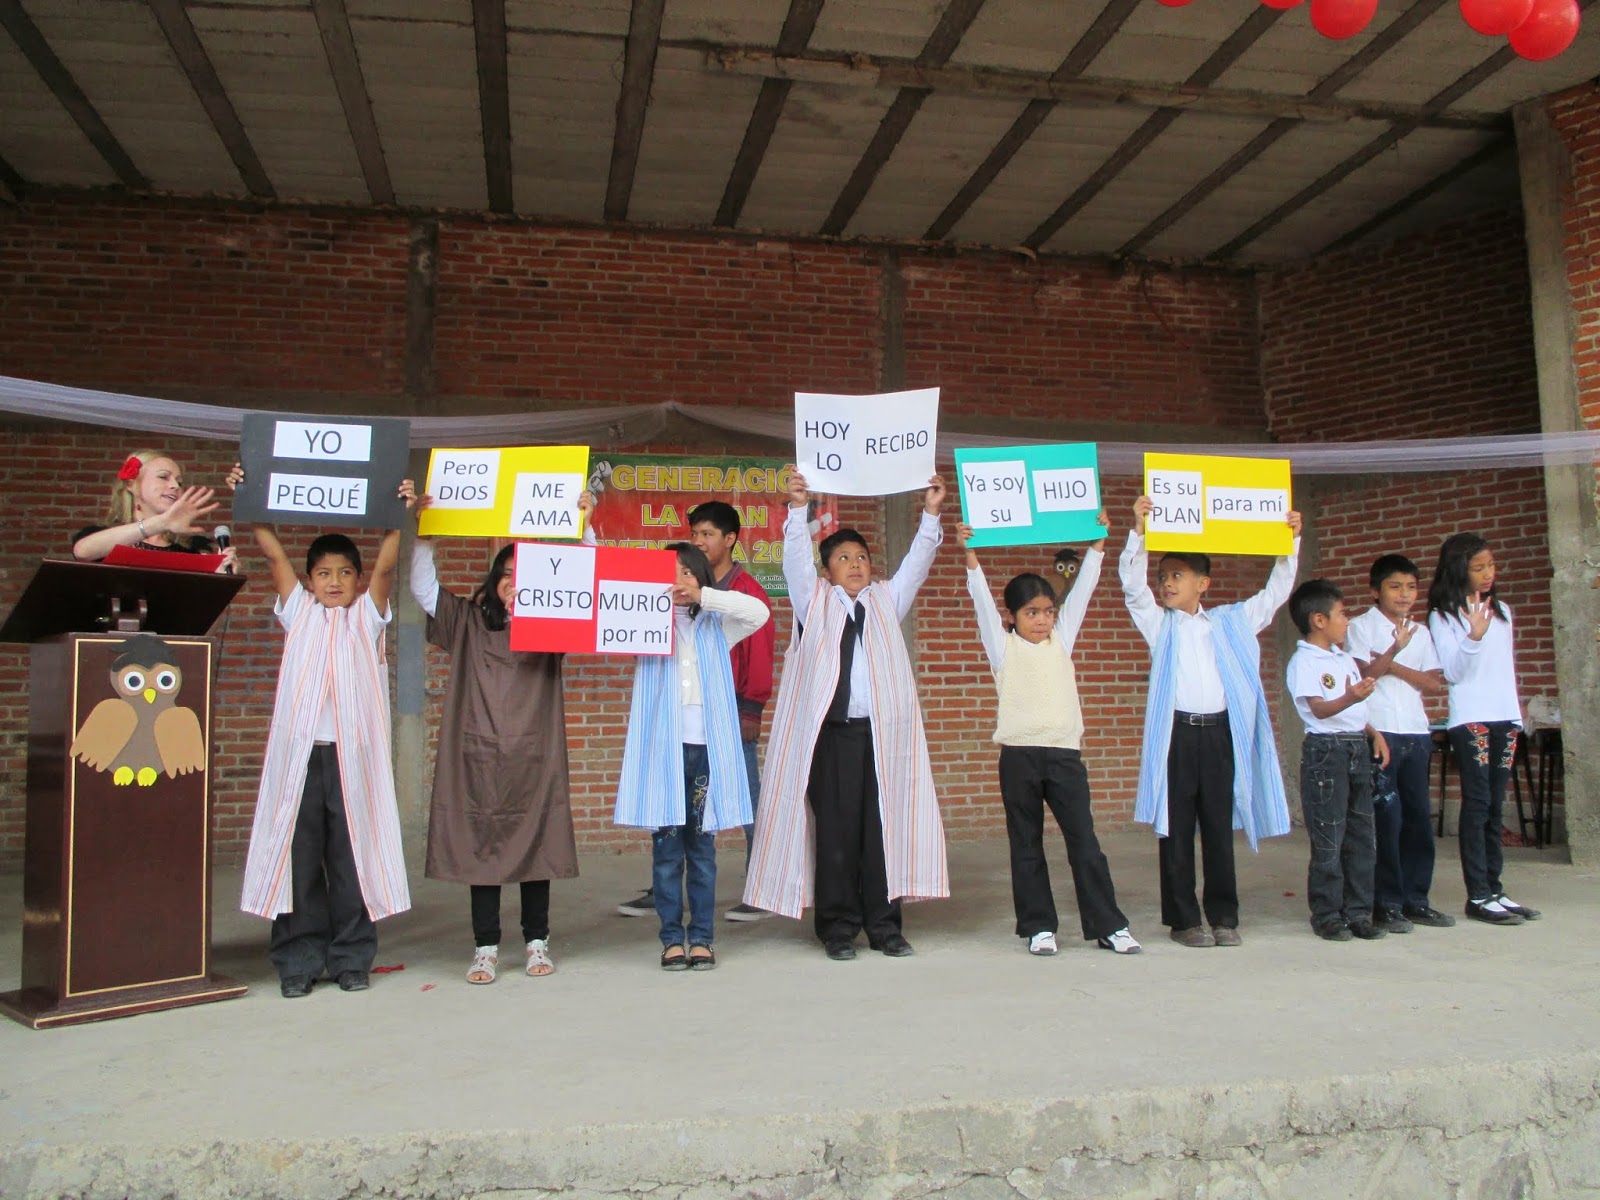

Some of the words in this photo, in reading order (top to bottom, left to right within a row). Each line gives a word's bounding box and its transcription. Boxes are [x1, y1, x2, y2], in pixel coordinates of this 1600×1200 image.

[805, 420, 850, 441] HOY
[304, 429, 342, 455] YO
[865, 429, 929, 456] RECIBO
[443, 460, 489, 476] Pero
[816, 452, 842, 472] LO
[611, 464, 792, 493] GENERACIÓ
[964, 474, 986, 493] Ya
[992, 476, 1025, 496] soy
[1152, 477, 1171, 495] Es
[1177, 481, 1198, 496] su
[276, 483, 361, 510] PEQUÉ
[438, 485, 489, 502] DIOS
[531, 483, 565, 499] ME
[1043, 479, 1088, 501] HIJO
[1212, 494, 1252, 514] para
[1260, 494, 1283, 513] mí
[520, 509, 573, 527] AMA
[641, 504, 681, 528] LA
[991, 508, 1012, 523] su
[1152, 506, 1201, 525] PLAN
[550, 557, 562, 576] Y
[517, 588, 592, 610] CRISTO
[599, 590, 671, 613] MURIÓ
[602, 627, 637, 647] por
[643, 625, 669, 644] mí
